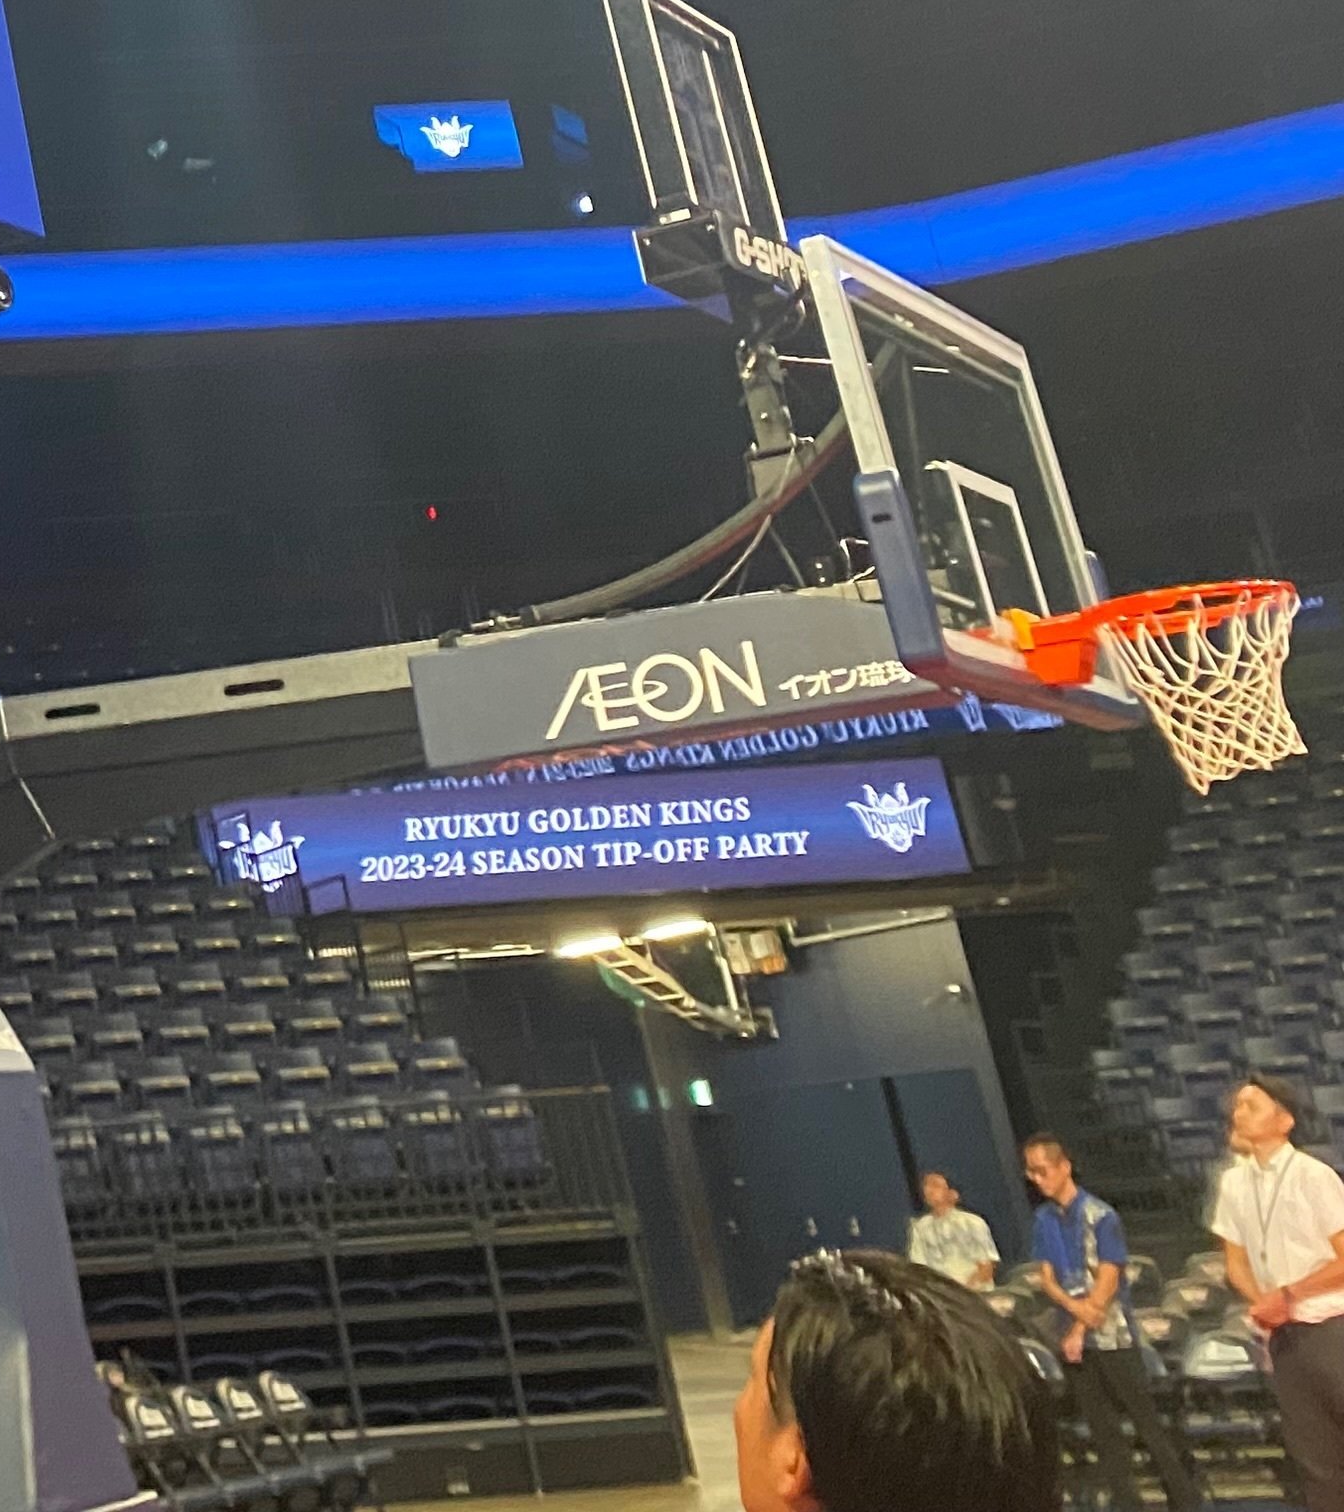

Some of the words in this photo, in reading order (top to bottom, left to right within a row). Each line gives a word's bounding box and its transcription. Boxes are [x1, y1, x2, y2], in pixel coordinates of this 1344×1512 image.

[405, 810, 521, 843] RYUKYU
[528, 801, 652, 834] GOLDEN
[658, 796, 752, 827] KINGS
[360, 850, 466, 883] 2023-24
[472, 842, 585, 876] SEASON
[591, 836, 710, 868] TIP-OFF
[716, 829, 811, 860] PARTY
